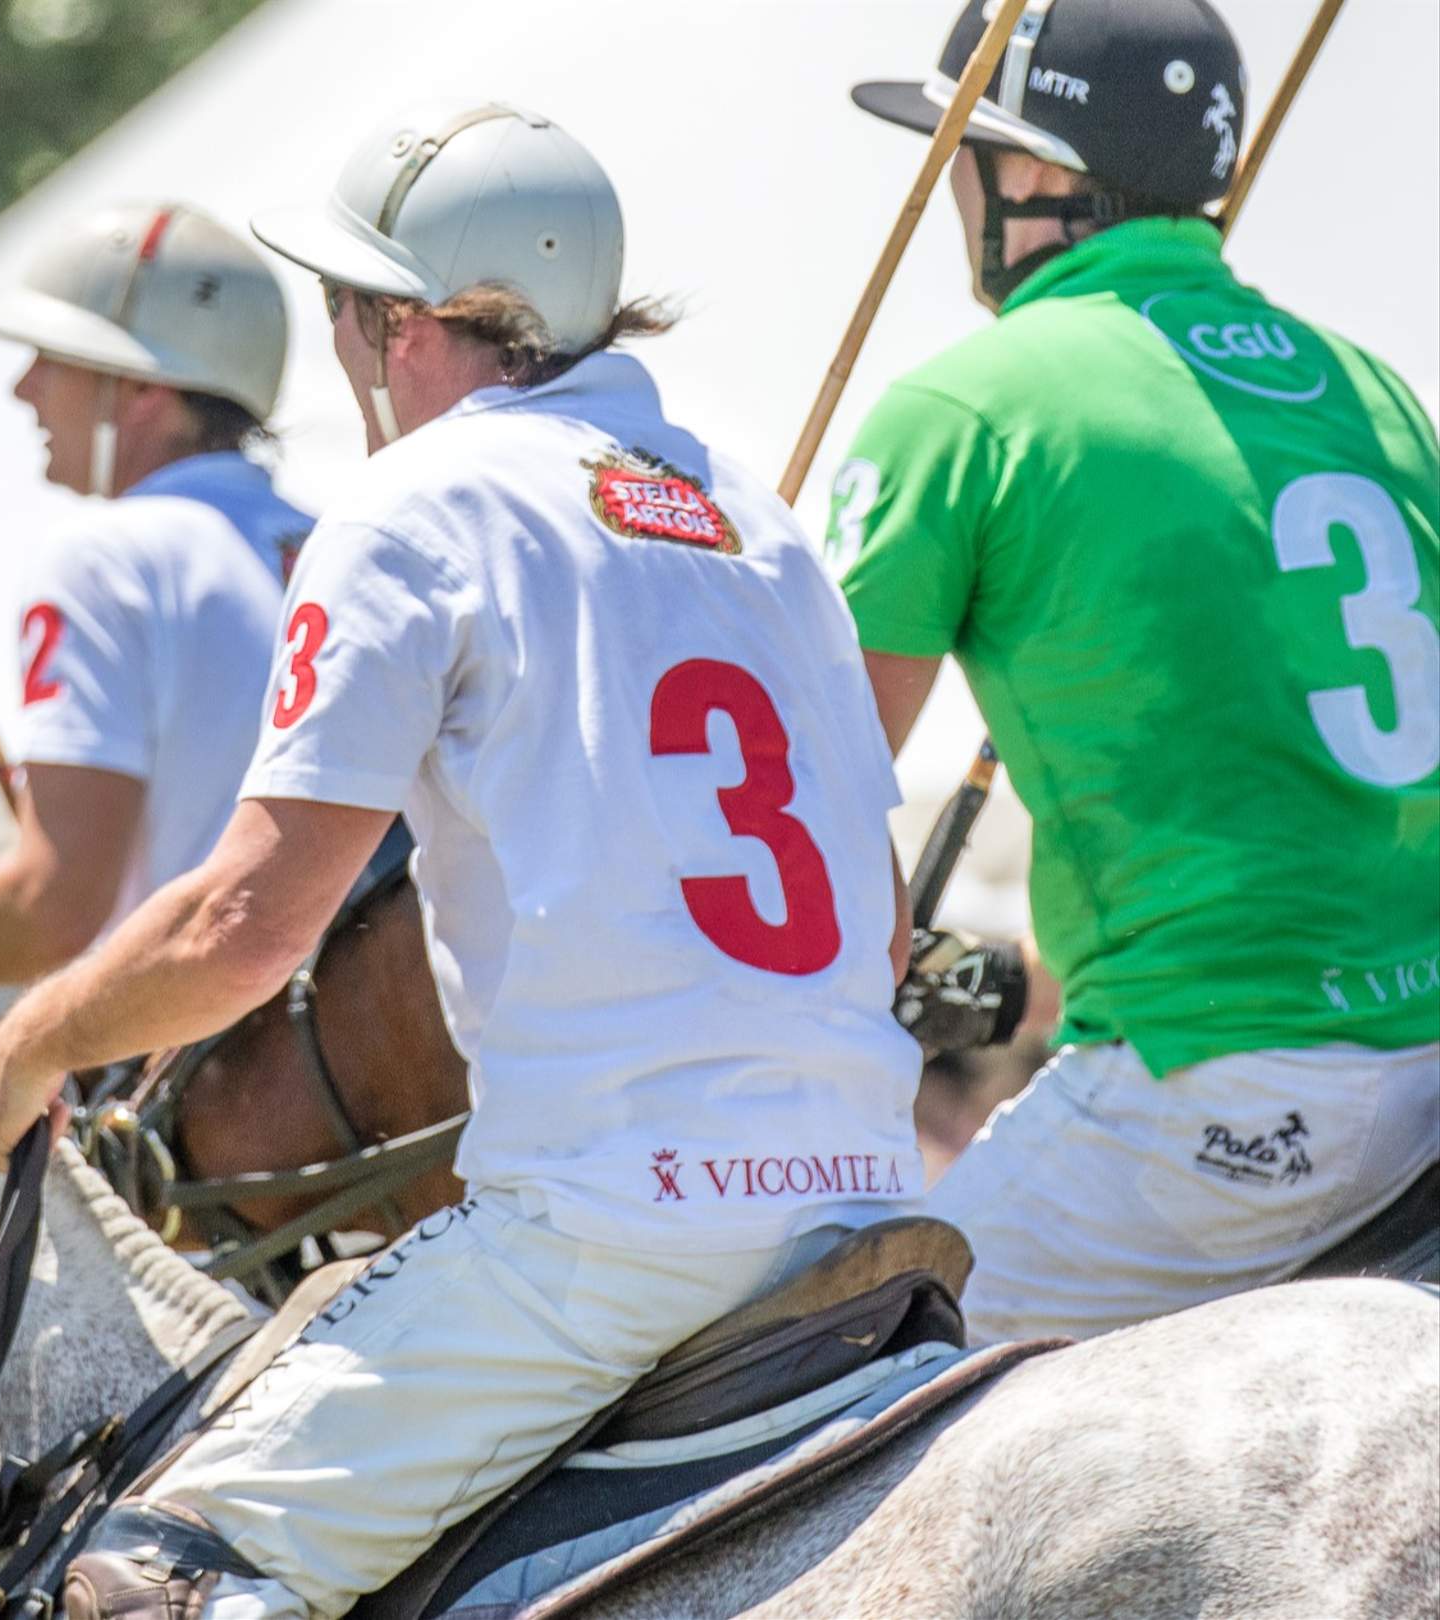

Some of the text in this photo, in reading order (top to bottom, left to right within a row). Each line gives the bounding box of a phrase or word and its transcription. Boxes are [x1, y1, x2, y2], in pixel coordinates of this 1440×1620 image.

[1028, 66, 1090, 104] MTR
[1188, 323, 1297, 360] CGU
[610, 479, 708, 514] STELLA
[623, 502, 717, 537] ARTOIS
[823, 457, 880, 583] 3
[21, 600, 66, 706] 2
[1271, 476, 1440, 788] 3
[273, 602, 329, 729] 3
[649, 658, 843, 977] 3
[1203, 1123, 1278, 1164] Polo
[701, 1155, 880, 1197] VICOMTE
